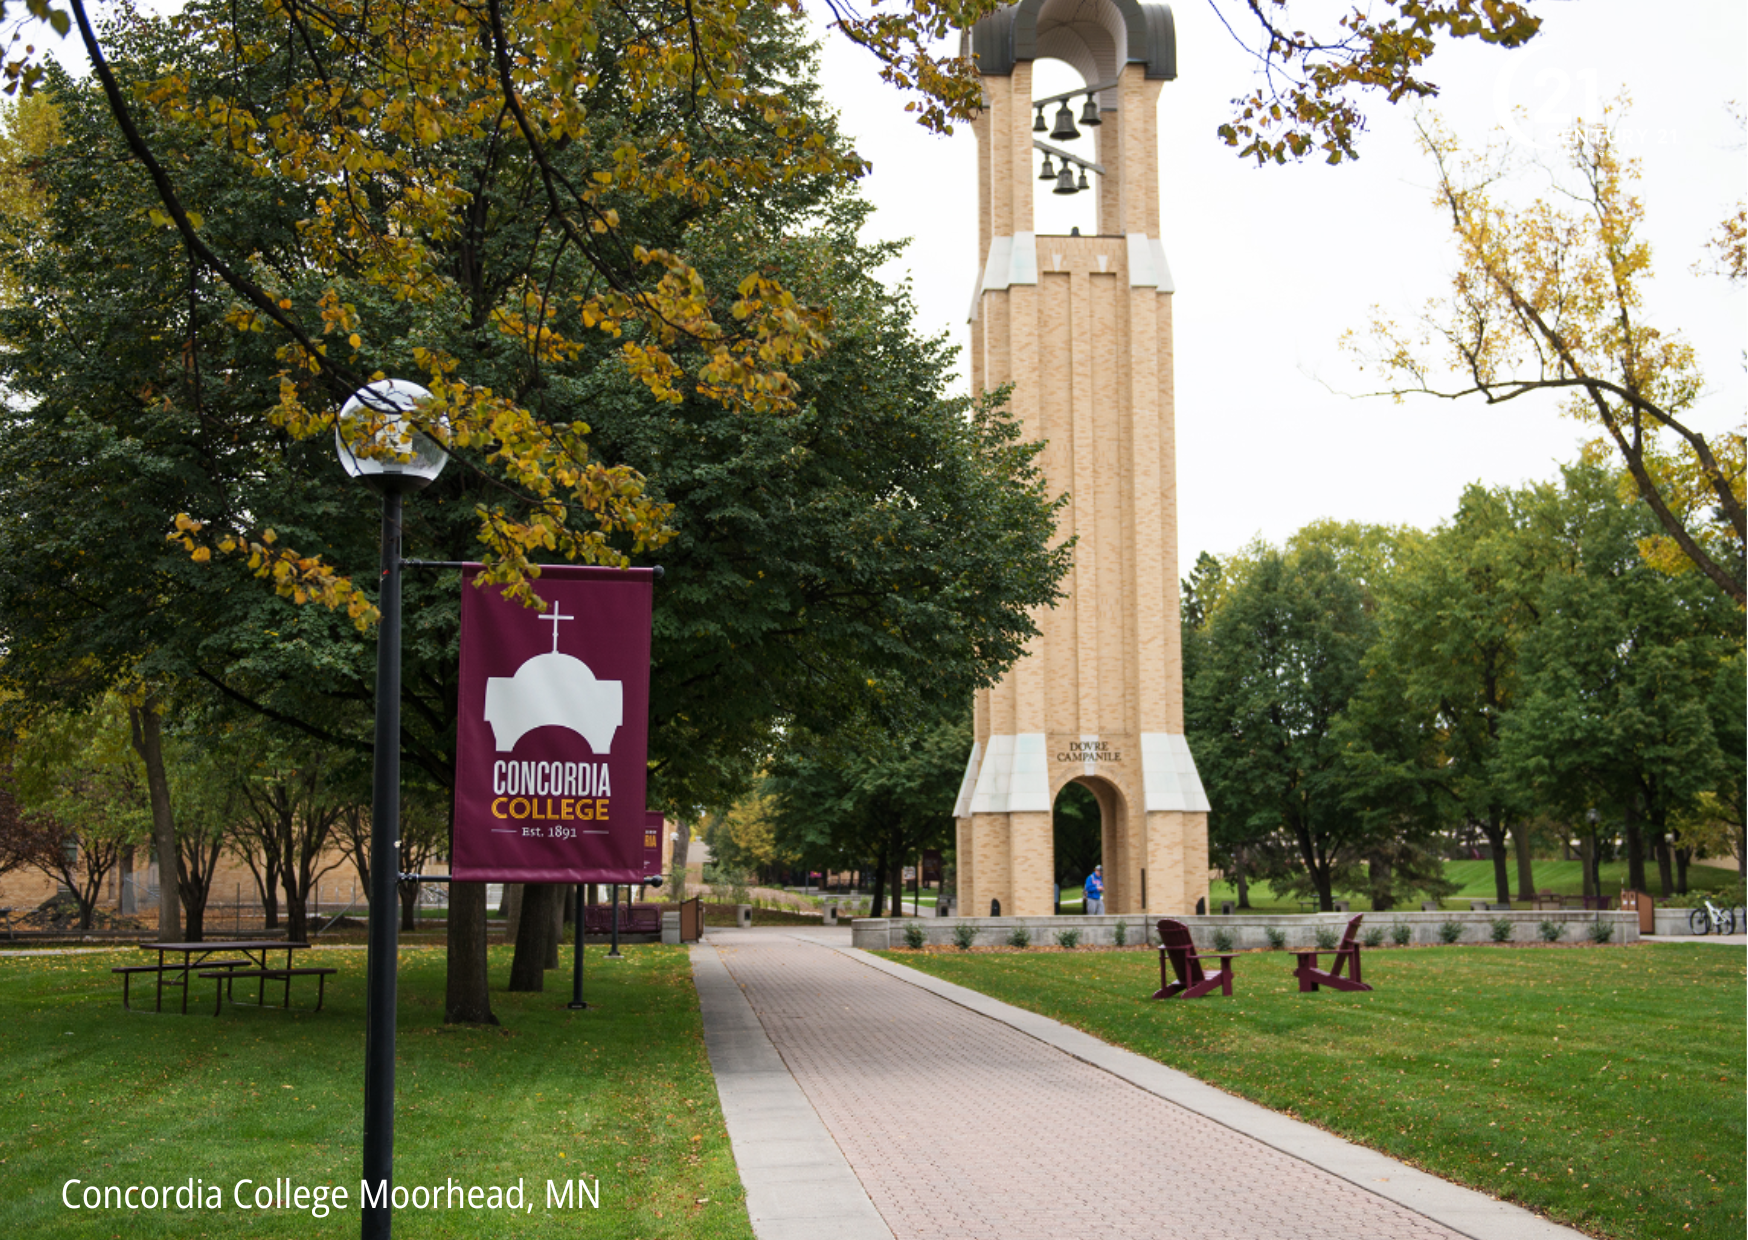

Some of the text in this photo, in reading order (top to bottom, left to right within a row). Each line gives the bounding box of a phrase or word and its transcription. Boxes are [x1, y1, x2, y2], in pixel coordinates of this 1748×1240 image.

[1069, 741, 1108, 751] DOVRE
[1056, 752, 1122, 762] CAMPANILE
[493, 760, 611, 797] CONCORDIA
[491, 797, 610, 820] COLLEGE
[521, 824, 577, 840] Est. 1891
